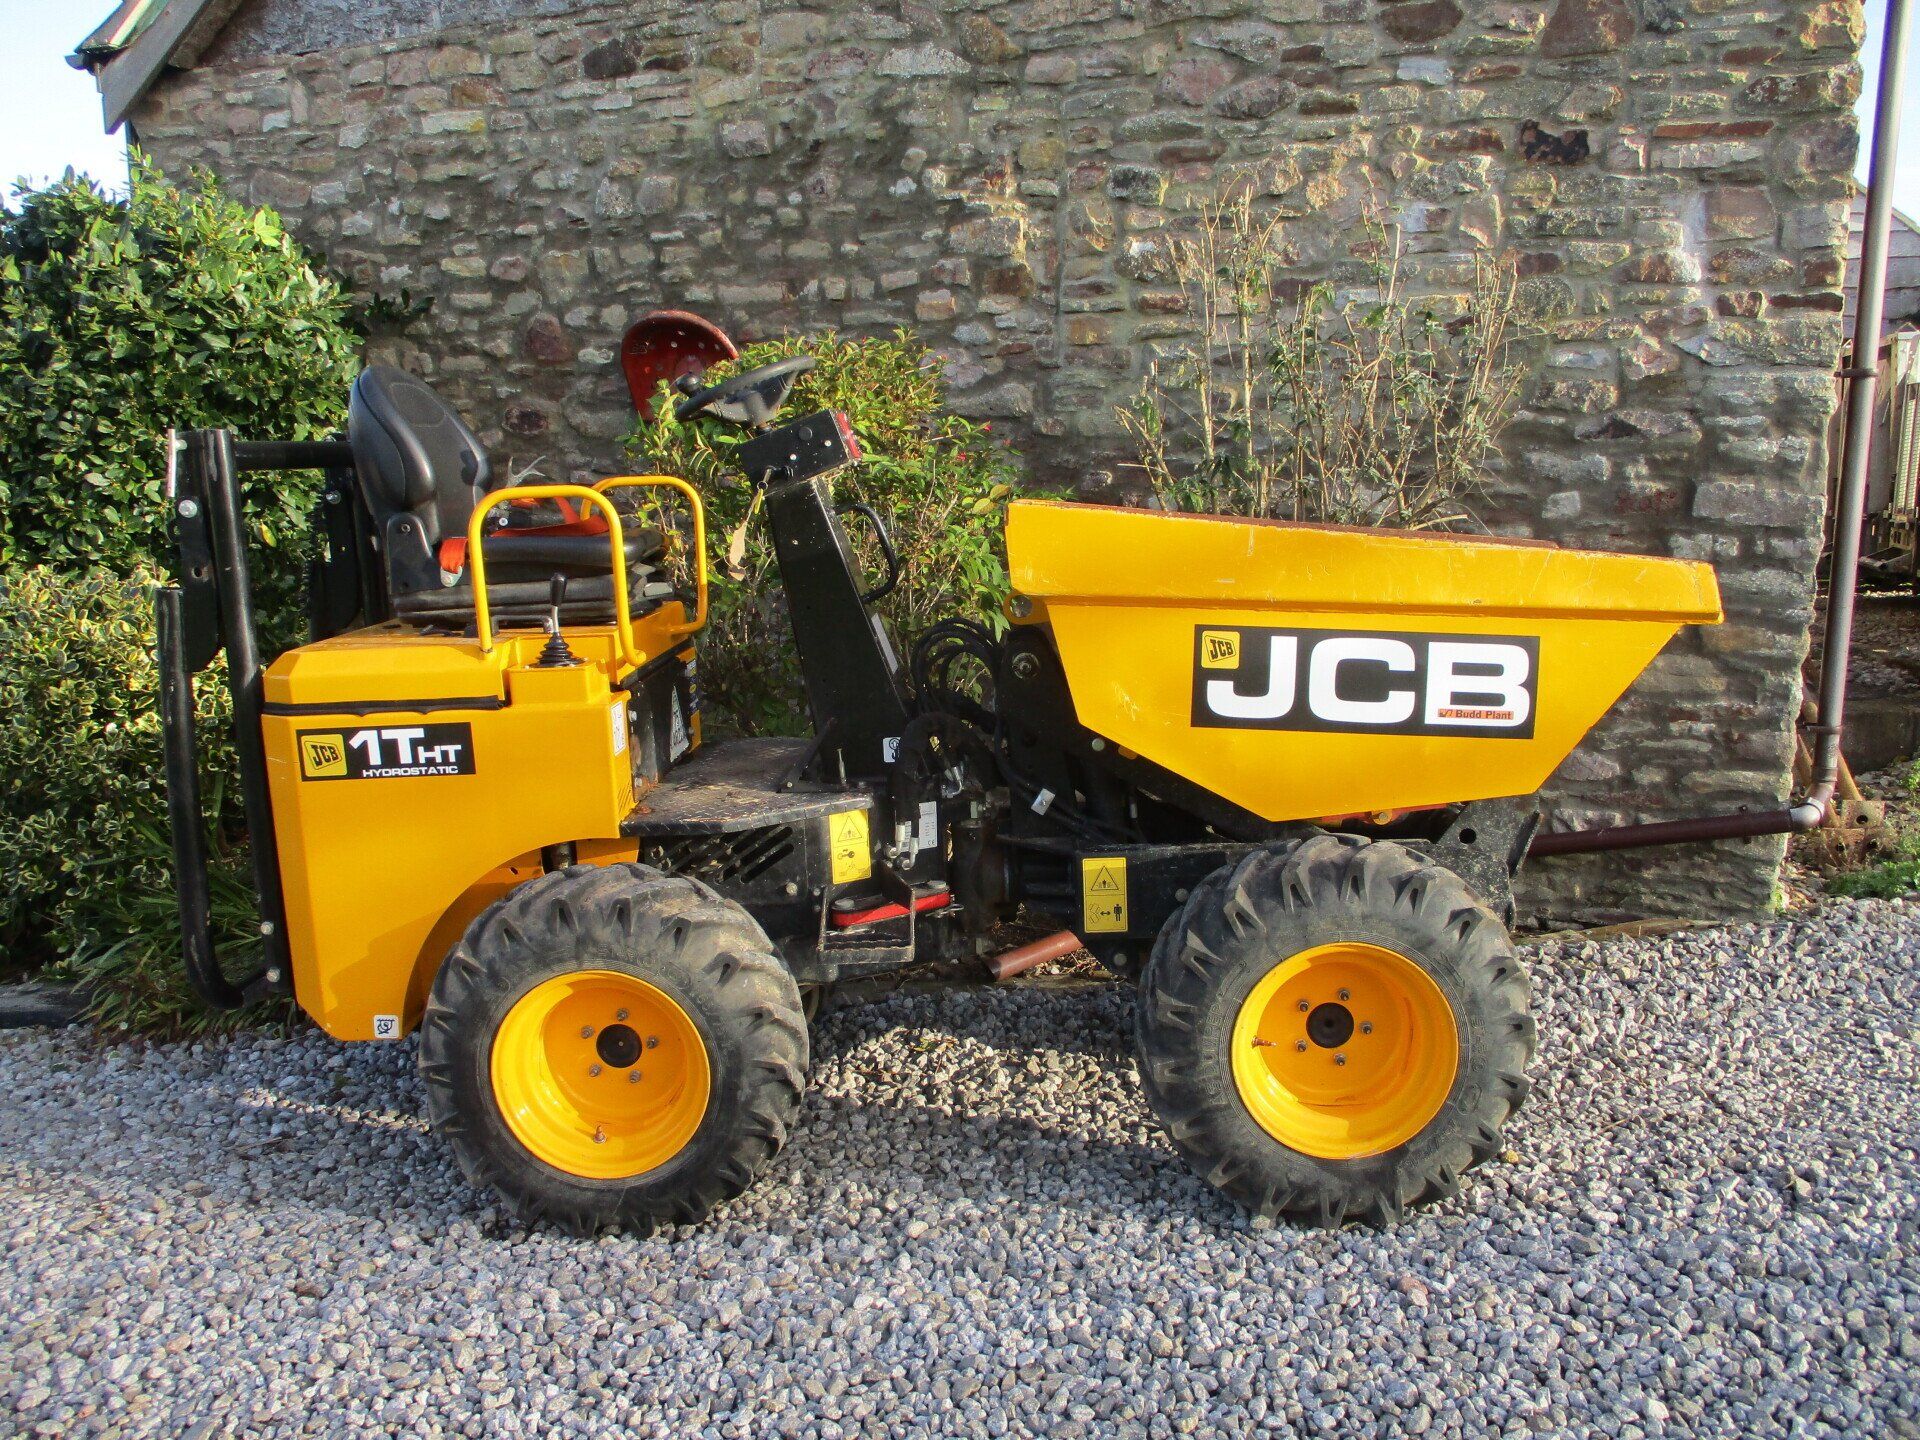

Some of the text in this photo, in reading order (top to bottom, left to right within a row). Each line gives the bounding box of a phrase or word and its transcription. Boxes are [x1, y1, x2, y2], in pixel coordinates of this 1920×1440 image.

[1210, 639, 1234, 660] JCB
[1206, 635, 1531, 728] JCB
[1455, 709, 1512, 720] Budd Plant
[310, 744, 339, 767] JCB
[362, 765, 459, 778] HYDROSTATIC
